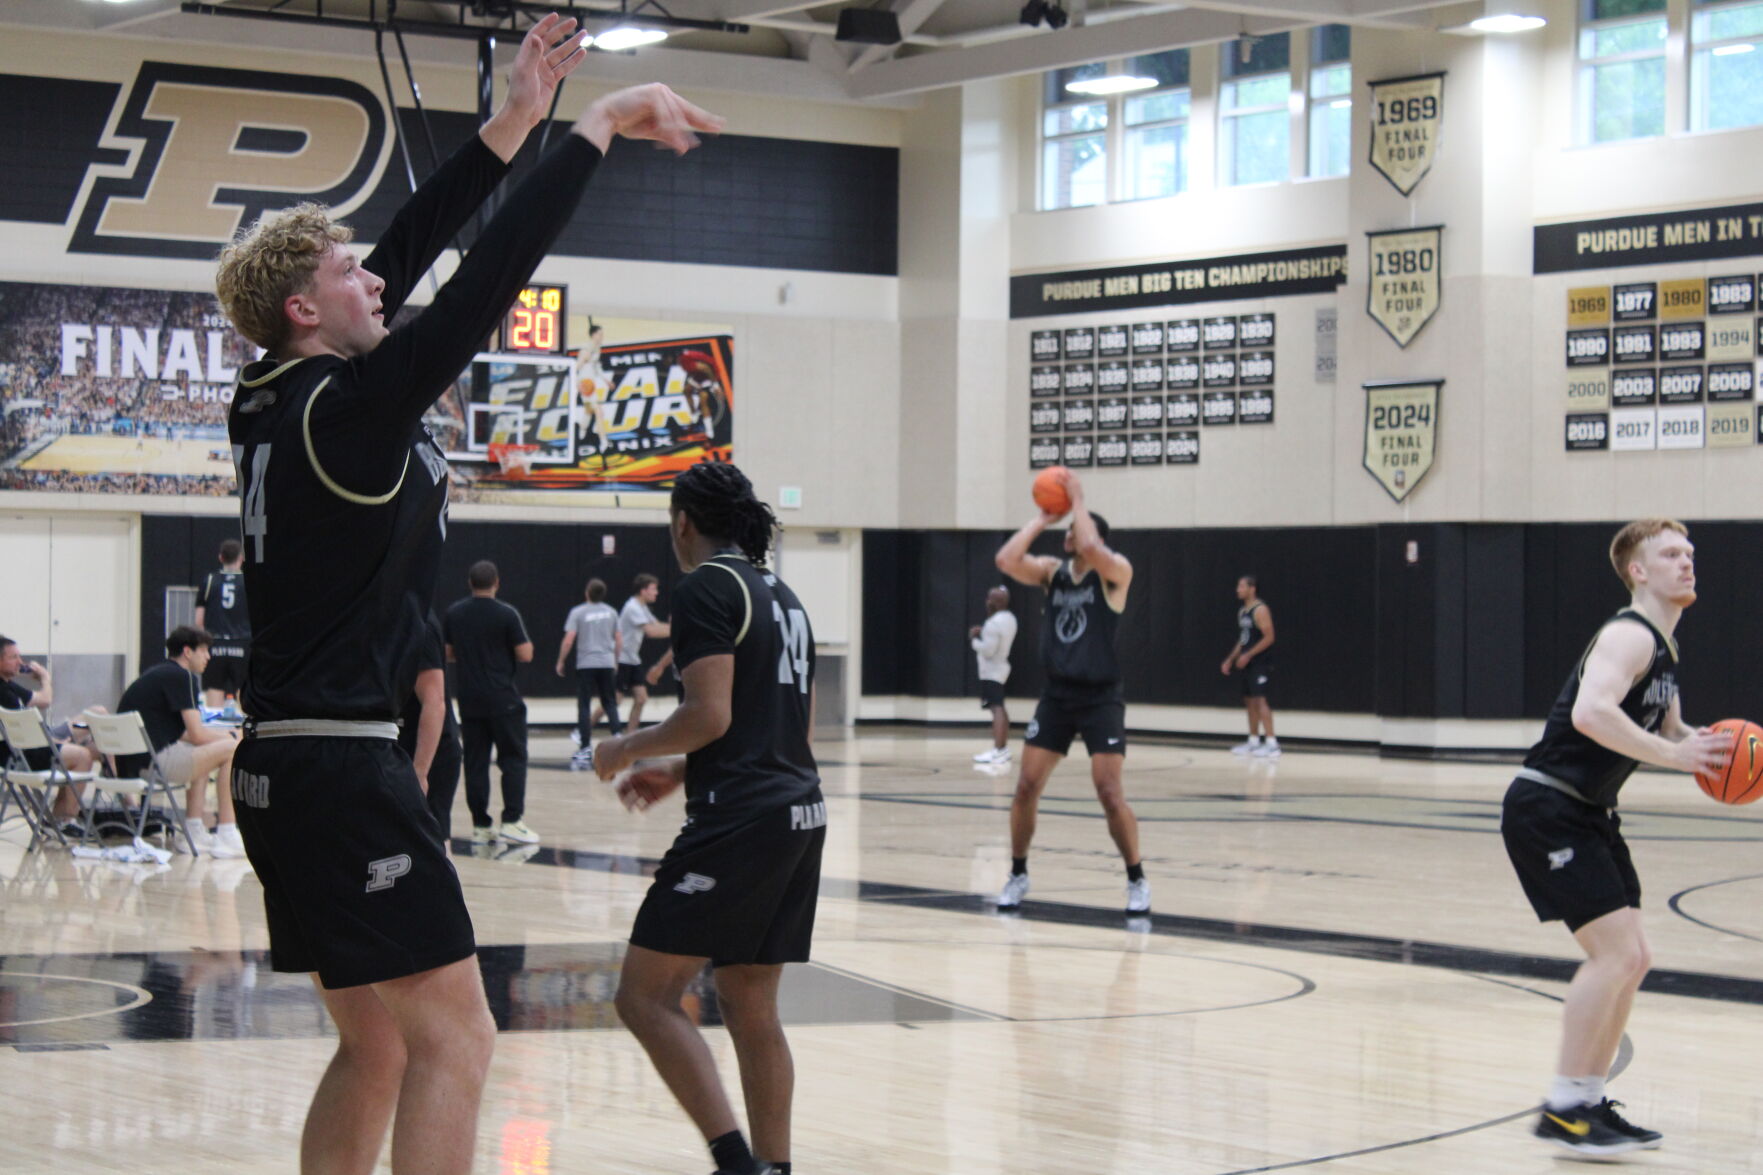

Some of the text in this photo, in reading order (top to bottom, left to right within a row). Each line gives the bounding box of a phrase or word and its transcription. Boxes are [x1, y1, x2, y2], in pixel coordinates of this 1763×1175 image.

[1378, 96, 1438, 126] 1969
[1385, 128, 1429, 145] FINAL
[67, 60, 387, 260] P
[1388, 145, 1426, 161] FOUR
[1577, 215, 1763, 255] PURDUE MEN IN T
[1376, 248, 1433, 276] 1980
[1043, 279, 1102, 301] PURDUE
[1104, 275, 1139, 296] MEN
[1142, 271, 1172, 293] BIG
[1174, 269, 1205, 290] TEN
[1383, 280, 1425, 296] FINAL
[1386, 297, 1423, 312] FOUR
[513, 311, 553, 347] 20
[61, 323, 238, 383] FINAL
[1661, 374, 1702, 394] 2007
[1374, 403, 1430, 430] 2024
[1616, 421, 1650, 438] 2017
[1711, 416, 1749, 434] 2019
[1381, 435, 1422, 450] FINAL
[1383, 452, 1419, 467] FOUR
[222, 583, 235, 609] 5
[772, 600, 809, 694] 24
[366, 853, 412, 893] P
[673, 872, 717, 895] P
